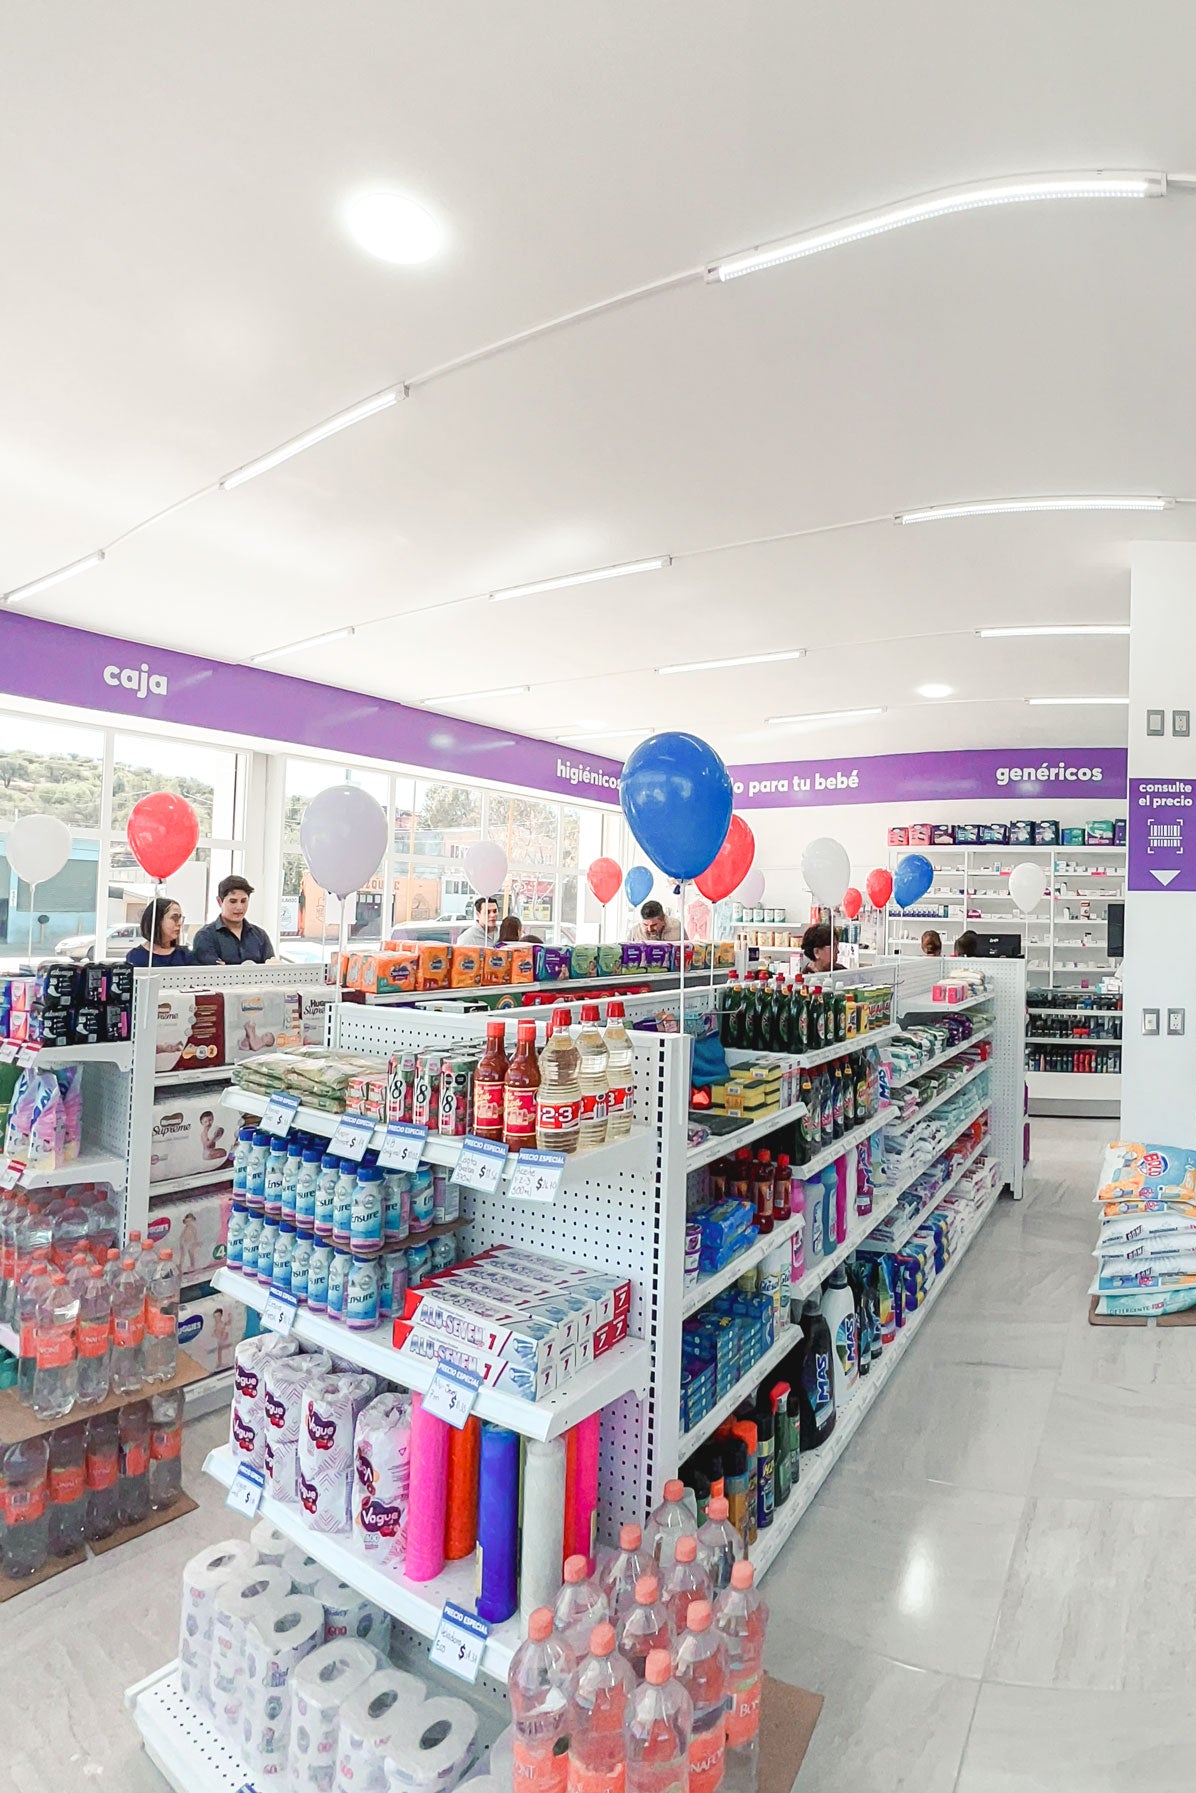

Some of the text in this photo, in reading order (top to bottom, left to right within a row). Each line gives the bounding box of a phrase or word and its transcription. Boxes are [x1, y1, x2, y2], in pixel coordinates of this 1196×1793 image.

[103, 663, 168, 698] caja
[996, 761, 1103, 786] genéricos
[749, 779, 789, 797] para
[793, 776, 811, 792] tu
[814, 770, 860, 791] bebé
[1138, 782, 1193, 795] consulte
[1138, 795, 1193, 809] el precio
[152, 1123, 192, 1136] Supreme
[214, 1245, 226, 1258] 4
[844, 1317, 856, 1363] MAS
[815, 1352, 830, 1403] MAS
[363, 1508, 400, 1526] Vogue
[458, 1643, 466, 1660] $
